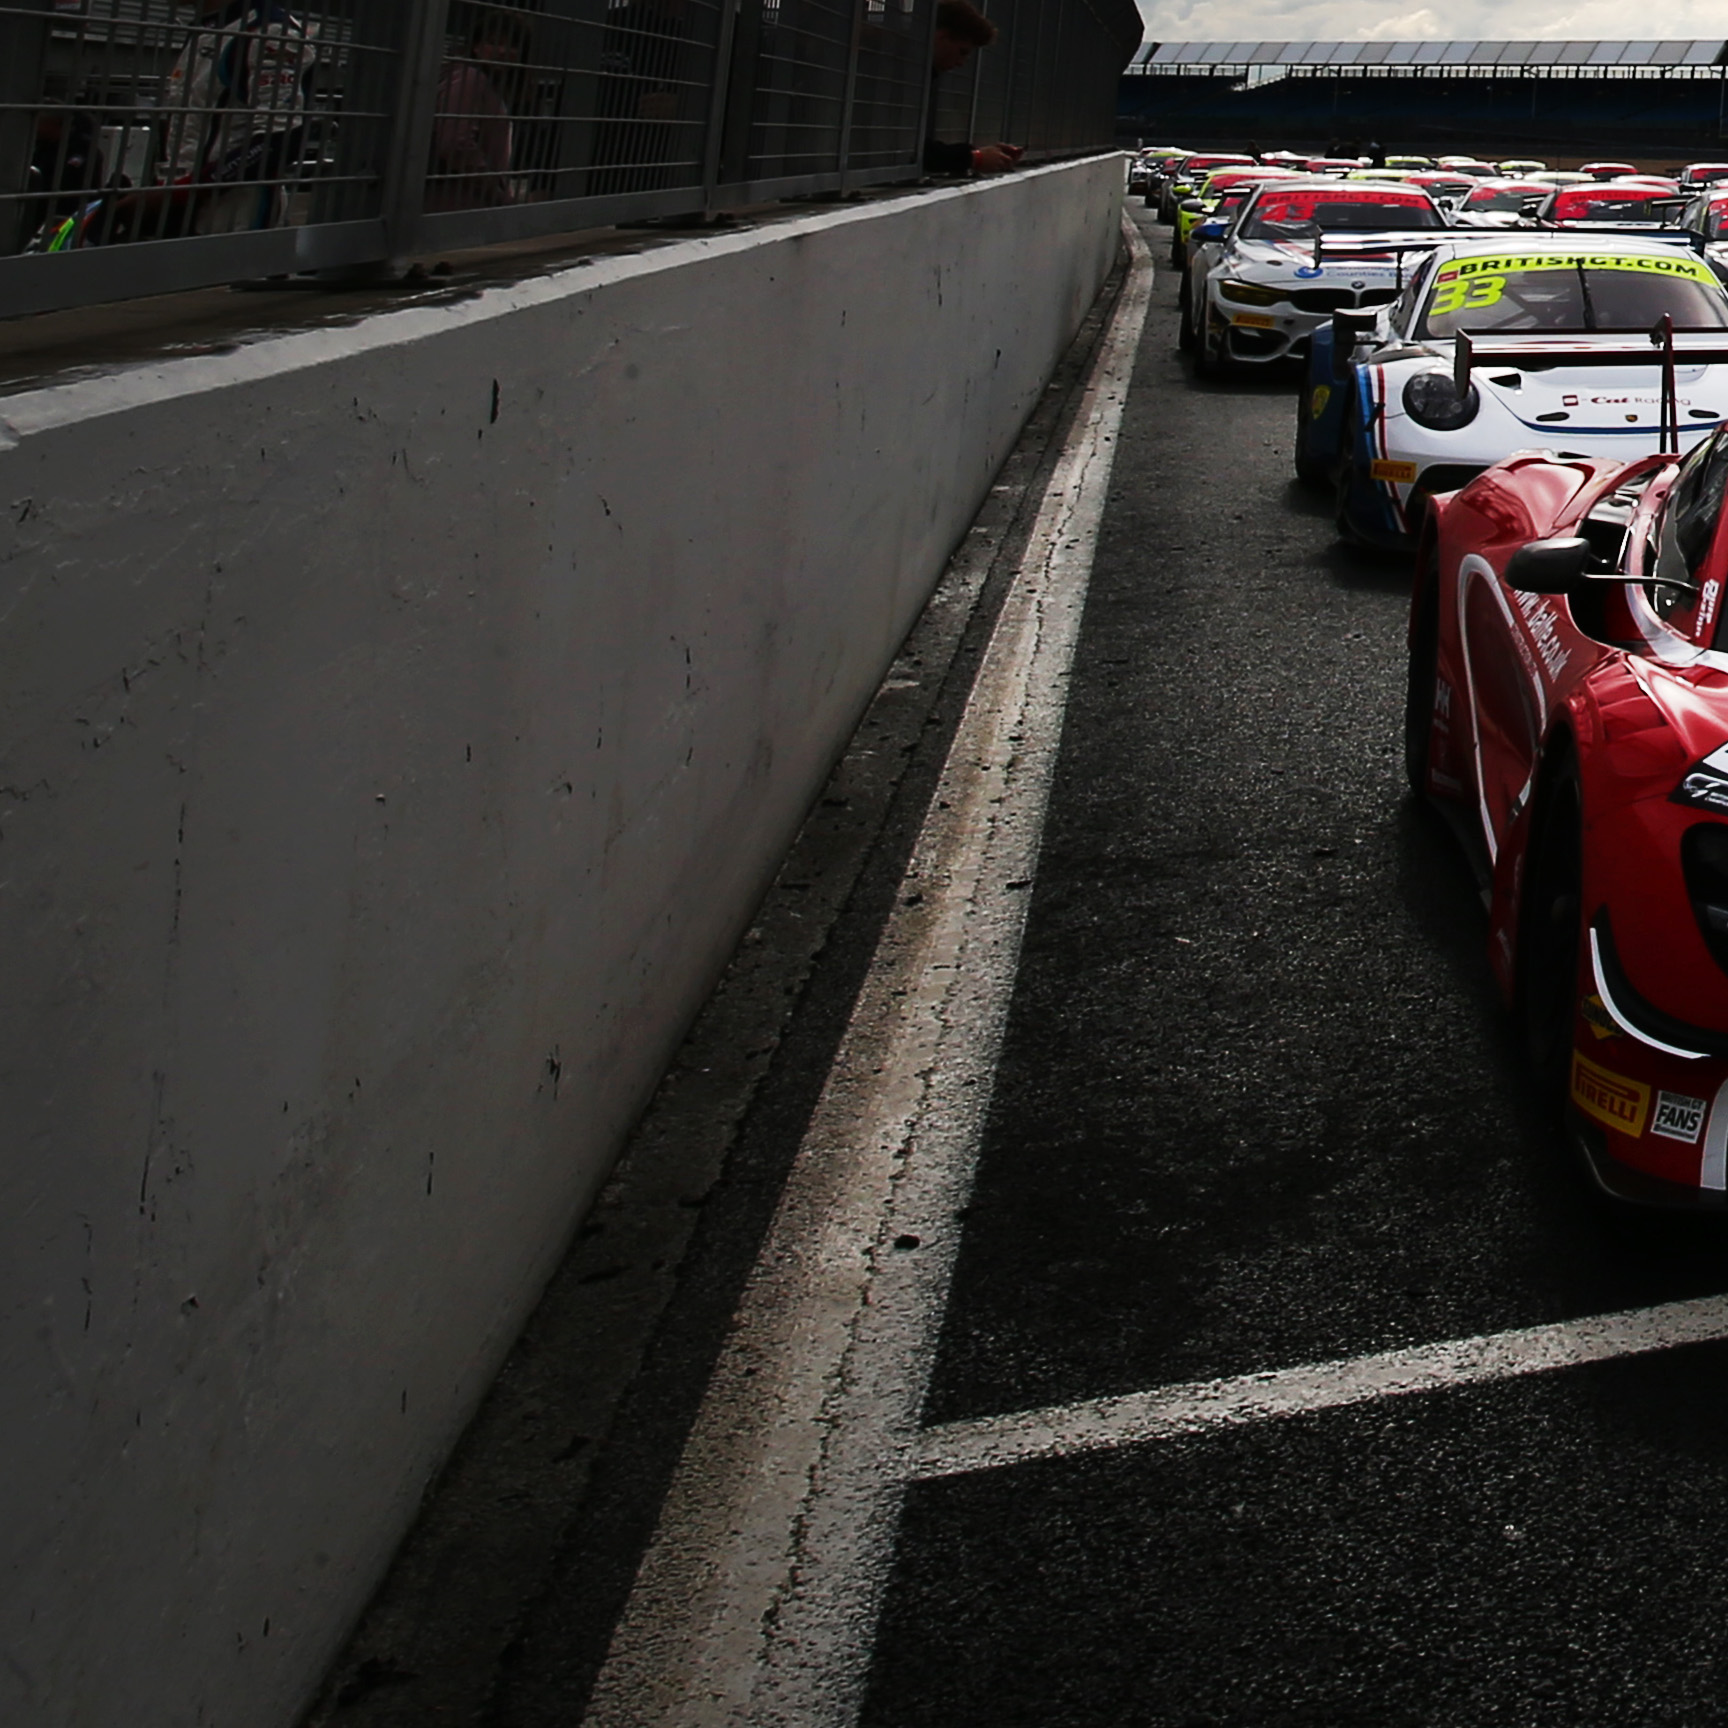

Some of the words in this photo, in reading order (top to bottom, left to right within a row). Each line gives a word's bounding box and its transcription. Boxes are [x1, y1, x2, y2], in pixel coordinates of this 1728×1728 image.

[1459, 256, 1698, 277] BRITISHGT.COM
[1428, 275, 1507, 317] 33
[1576, 1060, 1642, 1124] PIRELLI
[1656, 1104, 1700, 1132] FANS
